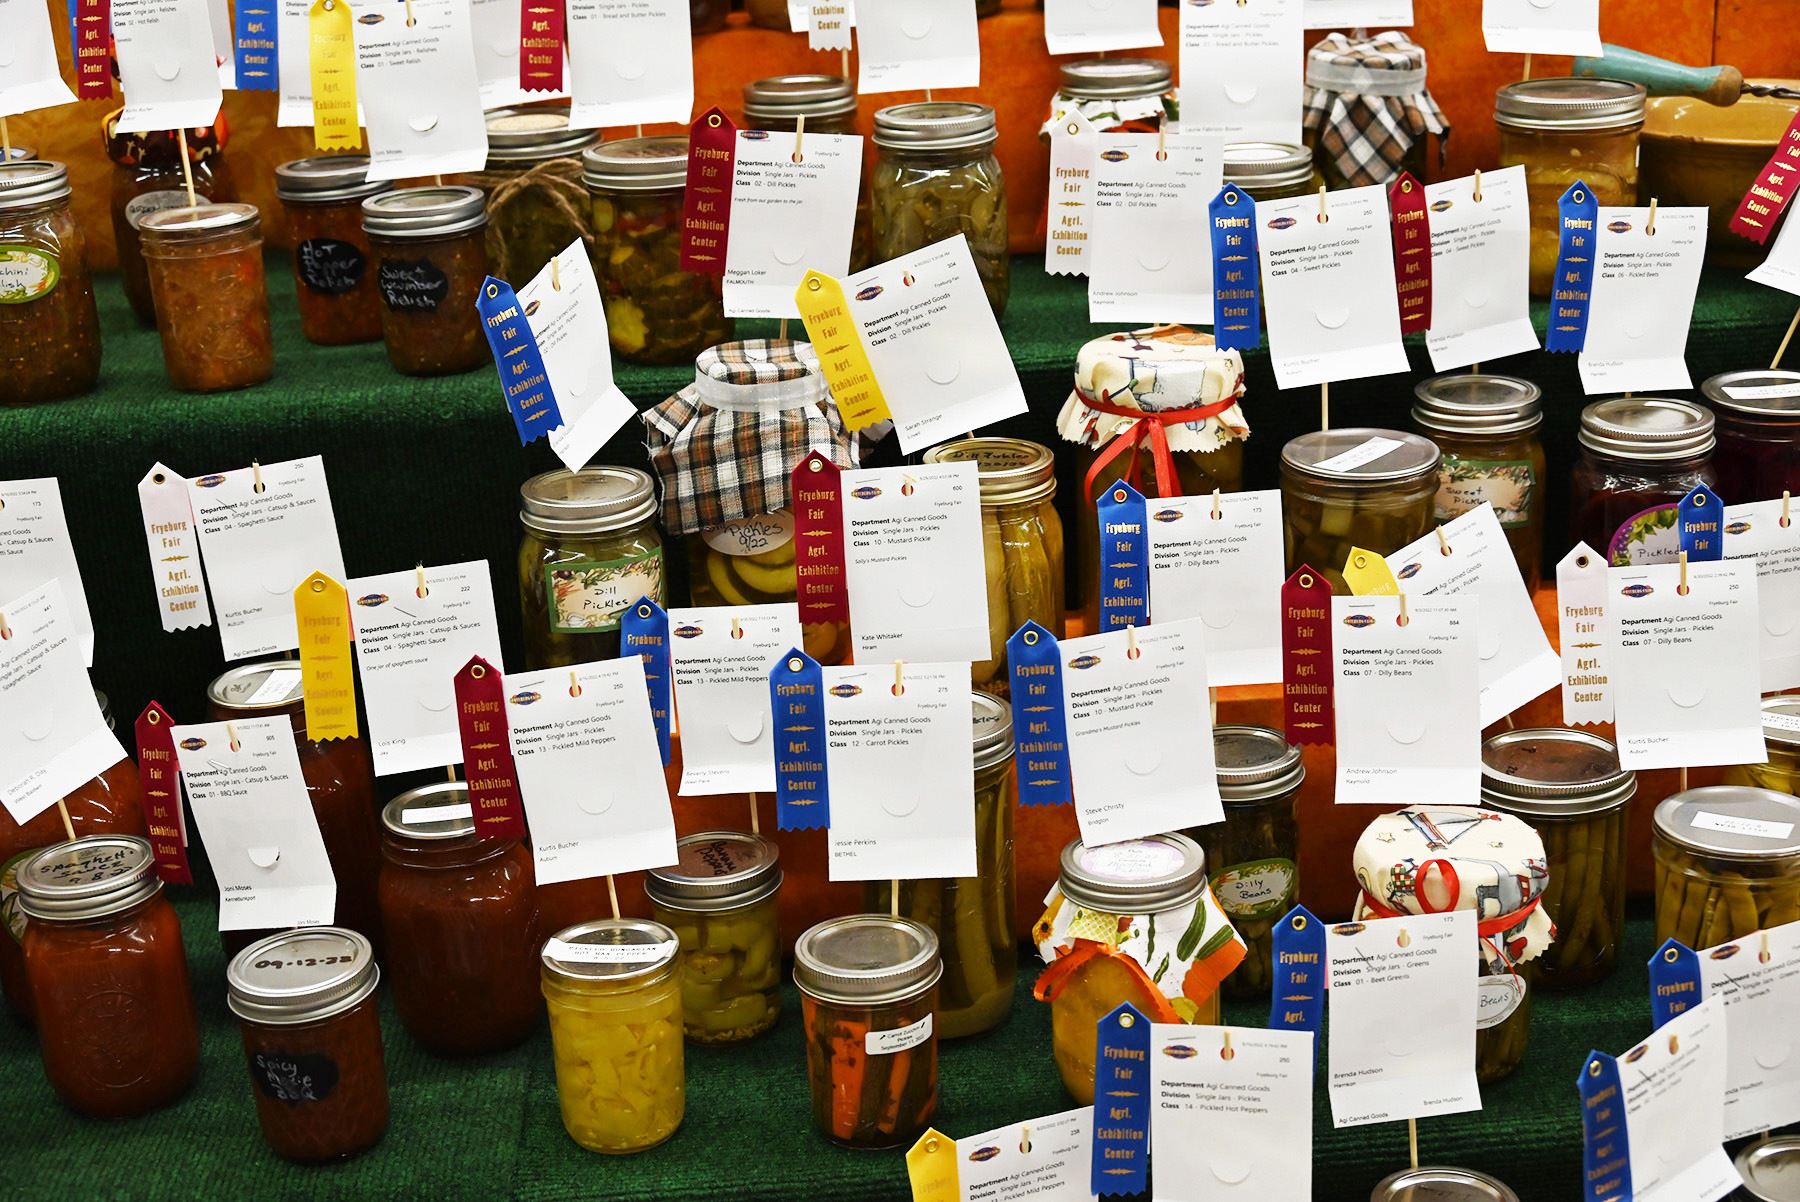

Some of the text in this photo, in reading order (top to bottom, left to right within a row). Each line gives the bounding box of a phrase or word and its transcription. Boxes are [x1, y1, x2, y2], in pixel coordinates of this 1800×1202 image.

[813, 6, 844, 15] Exhibition
[248, 23, 265, 33] Agri.
[818, 21, 840, 29] Center
[239, 39, 274, 48] Exhibition
[522, 38, 559, 48] Exhibition
[79, 47, 106, 57] Exhibition
[245, 55, 268, 64] Center
[528, 54, 553, 64] Center
[84, 64, 102, 73] Center
[322, 117, 347, 126] Center
[695, 147, 730, 161] Fryeburg
[1056, 167, 1090, 178] Fryeburg
[1064, 183, 1081, 193] Fair
[1751, 185, 1784, 204] Exhibition
[697, 201, 716, 212] Agri.
[1747, 200, 1770, 215] Center
[1397, 210, 1424, 224] Fryeburg
[686, 218, 724, 231] Exhibition
[1216, 217, 1249, 229] Fryeburg
[1565, 218, 1592, 230] Fryeburg
[1052, 230, 1088, 240] Exhibition
[1405, 229, 1418, 240] Fair
[691, 236, 717, 247] Center
[1226, 236, 1241, 245] Fair
[1056, 246, 1082, 255] Center
[1226, 271, 1244, 281] Agri.
[1566, 272, 1581, 283] Agri.
[1398, 279, 1428, 293] Exhibition
[1217, 290, 1254, 300] Exhibition
[1555, 290, 1588, 300] Exhibition
[1403, 296, 1424, 308] Center
[487, 306, 518, 328] Fryeburg
[808, 306, 841, 324] Fryeburg
[1224, 307, 1249, 317] Center
[1559, 307, 1580, 317] Center
[868, 325, 892, 337] Division
[871, 321, 930, 347] Class Pickles
[512, 360, 530, 375] Agri.
[509, 374, 544, 396] Exhibition
[831, 373, 869, 393] Exhibition
[520, 392, 544, 409] Center
[844, 392, 869, 406] Center
[799, 490, 835, 502] Fryeburg
[808, 509, 824, 519] Fair
[151, 521, 187, 534] Fryeburg
[205, 526, 221, 534] Class
[1106, 523, 1141, 534] Fryeburg
[1685, 521, 1717, 533] Fryeburg
[163, 537, 181, 548] Fair
[169, 569, 191, 581] Agri.
[799, 565, 840, 576] Exhibition
[806, 584, 834, 593] Center
[1114, 577, 1132, 589] Agri.
[161, 584, 199, 598] Exhibition
[594, 587, 617, 595] Dill
[169, 600, 196, 612] Center
[583, 599, 628, 610] Pickles
[1104, 596, 1142, 607] Exhibition
[1288, 608, 1325, 619] Fryeburg
[1565, 607, 1603, 617] Fryeburg
[1111, 614, 1136, 624] Center
[1297, 627, 1314, 637] Fair
[1576, 623, 1595, 632] Fair
[1017, 664, 1055, 677] Fryeburg
[1296, 664, 1316, 676] Agri.
[1568, 675, 1608, 686] Exhibition
[777, 684, 815, 696] Fryeburg
[1071, 687, 1111, 698] Department
[1286, 684, 1328, 694] Exhibition
[1574, 692, 1603, 702] Center
[464, 701, 499, 714] Fryeburg
[790, 704, 807, 714] Fair
[1109, 703, 1134, 713] Mustard
[1136, 699, 1153, 707] Pickle
[1294, 703, 1321, 712] Center
[1030, 722, 1050, 733] Agri.
[516, 736, 542, 745] Division
[552, 742, 574, 750] Pickled
[575, 739, 589, 747] Mild
[590, 737, 616, 746] Peppers
[1020, 742, 1064, 752] Exhibition
[143, 748, 169, 761] Fryeburg
[780, 761, 822, 772] Exhibition
[1028, 760, 1057, 771] Center
[471, 778, 511, 791] Exhibition
[788, 780, 816, 790] Center
[480, 797, 507, 808] Center
[150, 825, 178, 837] Exhibition
[158, 844, 177, 854] Center
[1280, 952, 1318, 964] Fryeburg
[1291, 973, 1308, 984] Fair
[1657, 981, 1694, 996] Fryeburg
[1670, 1002, 1686, 1013] Fair
[1285, 1011, 1305, 1023] Agri.
[1104, 1046, 1144, 1061] Fryeburg
[1115, 1068, 1133, 1079] Fair
[1161, 1080, 1204, 1089] Department
[1240, 1106, 1268, 1114] Peppers
[1097, 1128, 1143, 1139] Exhibition
[1104, 1148, 1136, 1158] Center
[969, 1176, 1008, 1191] Department
